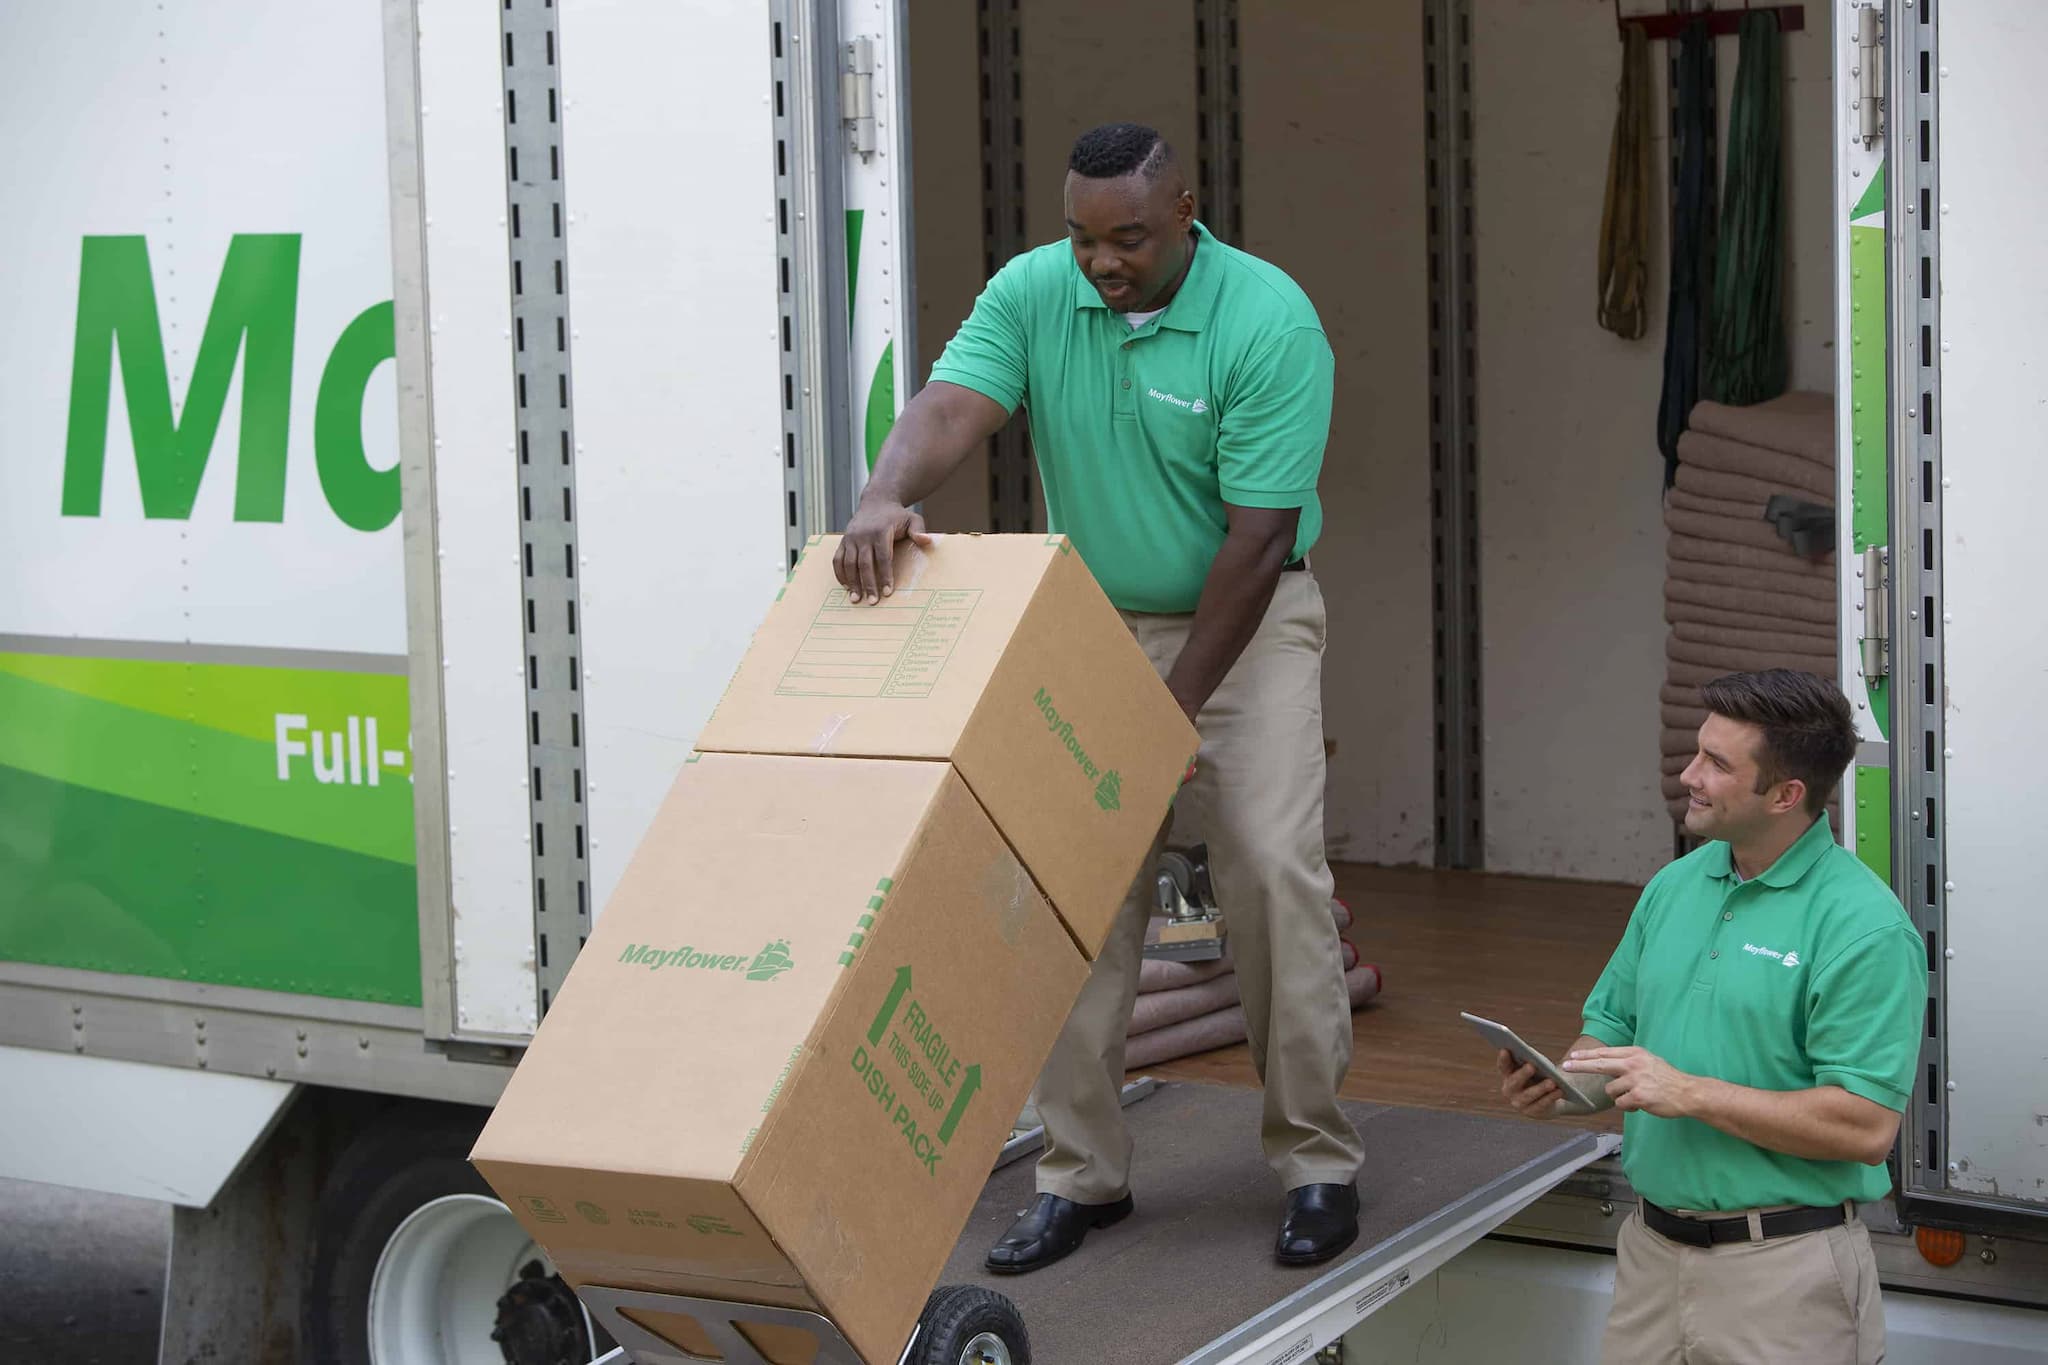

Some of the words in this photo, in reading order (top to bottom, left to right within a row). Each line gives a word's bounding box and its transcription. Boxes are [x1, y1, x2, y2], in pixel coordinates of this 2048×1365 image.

[1147, 387, 1192, 409] Mayflower
[275, 713, 414, 788] Full-
[1033, 686, 1099, 781] Mayflower
[618, 943, 749, 971] Mayflower
[888, 1031, 911, 1070] THIS
[908, 1061, 931, 1097] SIDE
[927, 1088, 945, 1112] UP
[903, 1000, 961, 1088] FRAGILE
[850, 1045, 896, 1113] DISH
[892, 1103, 942, 1177] PACK
